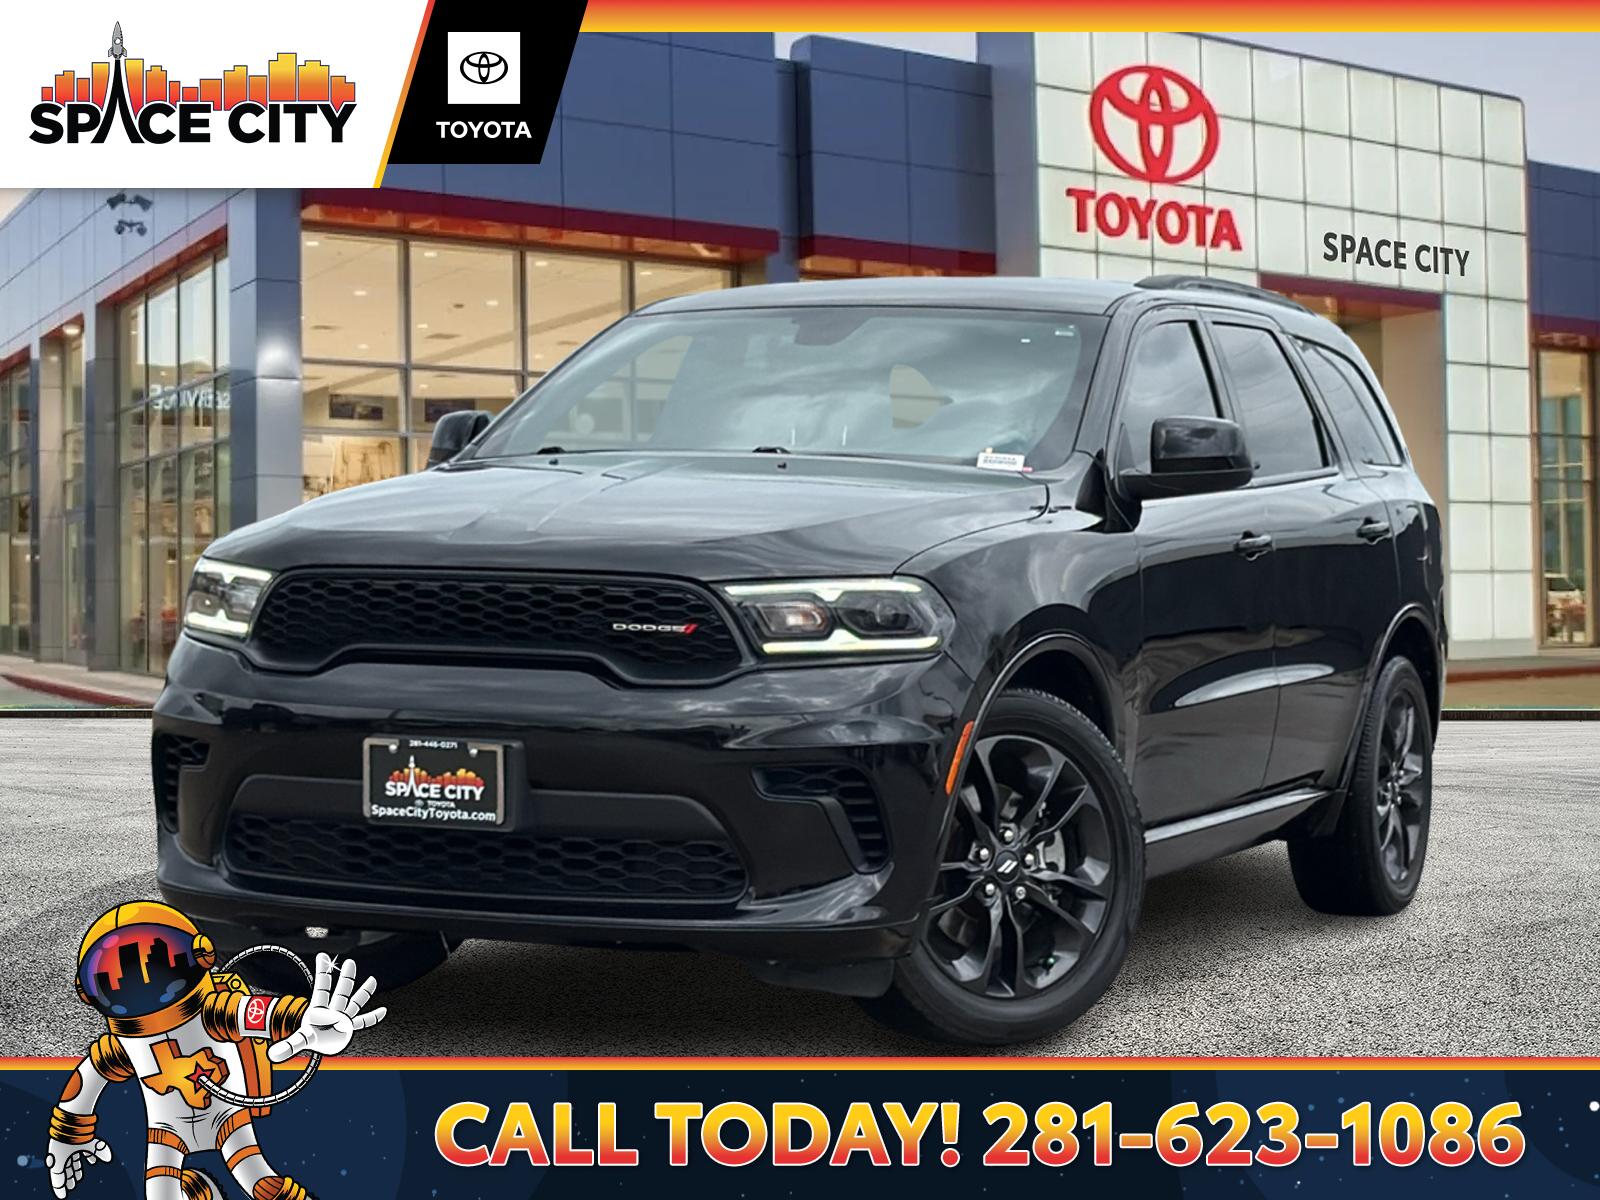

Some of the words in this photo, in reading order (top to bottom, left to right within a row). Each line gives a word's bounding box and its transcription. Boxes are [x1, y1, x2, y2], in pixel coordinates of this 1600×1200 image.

[1066, 187, 1243, 251] TOYOTA
[1323, 232, 1407, 270] SPACE
[1415, 244, 1471, 277] CITY
[612, 623, 684, 632] DODGE
[443, 785, 485, 801] CITY
[427, 800, 456, 808] TOYOTA
[371, 804, 497, 822] SpaceCityToyota.com
